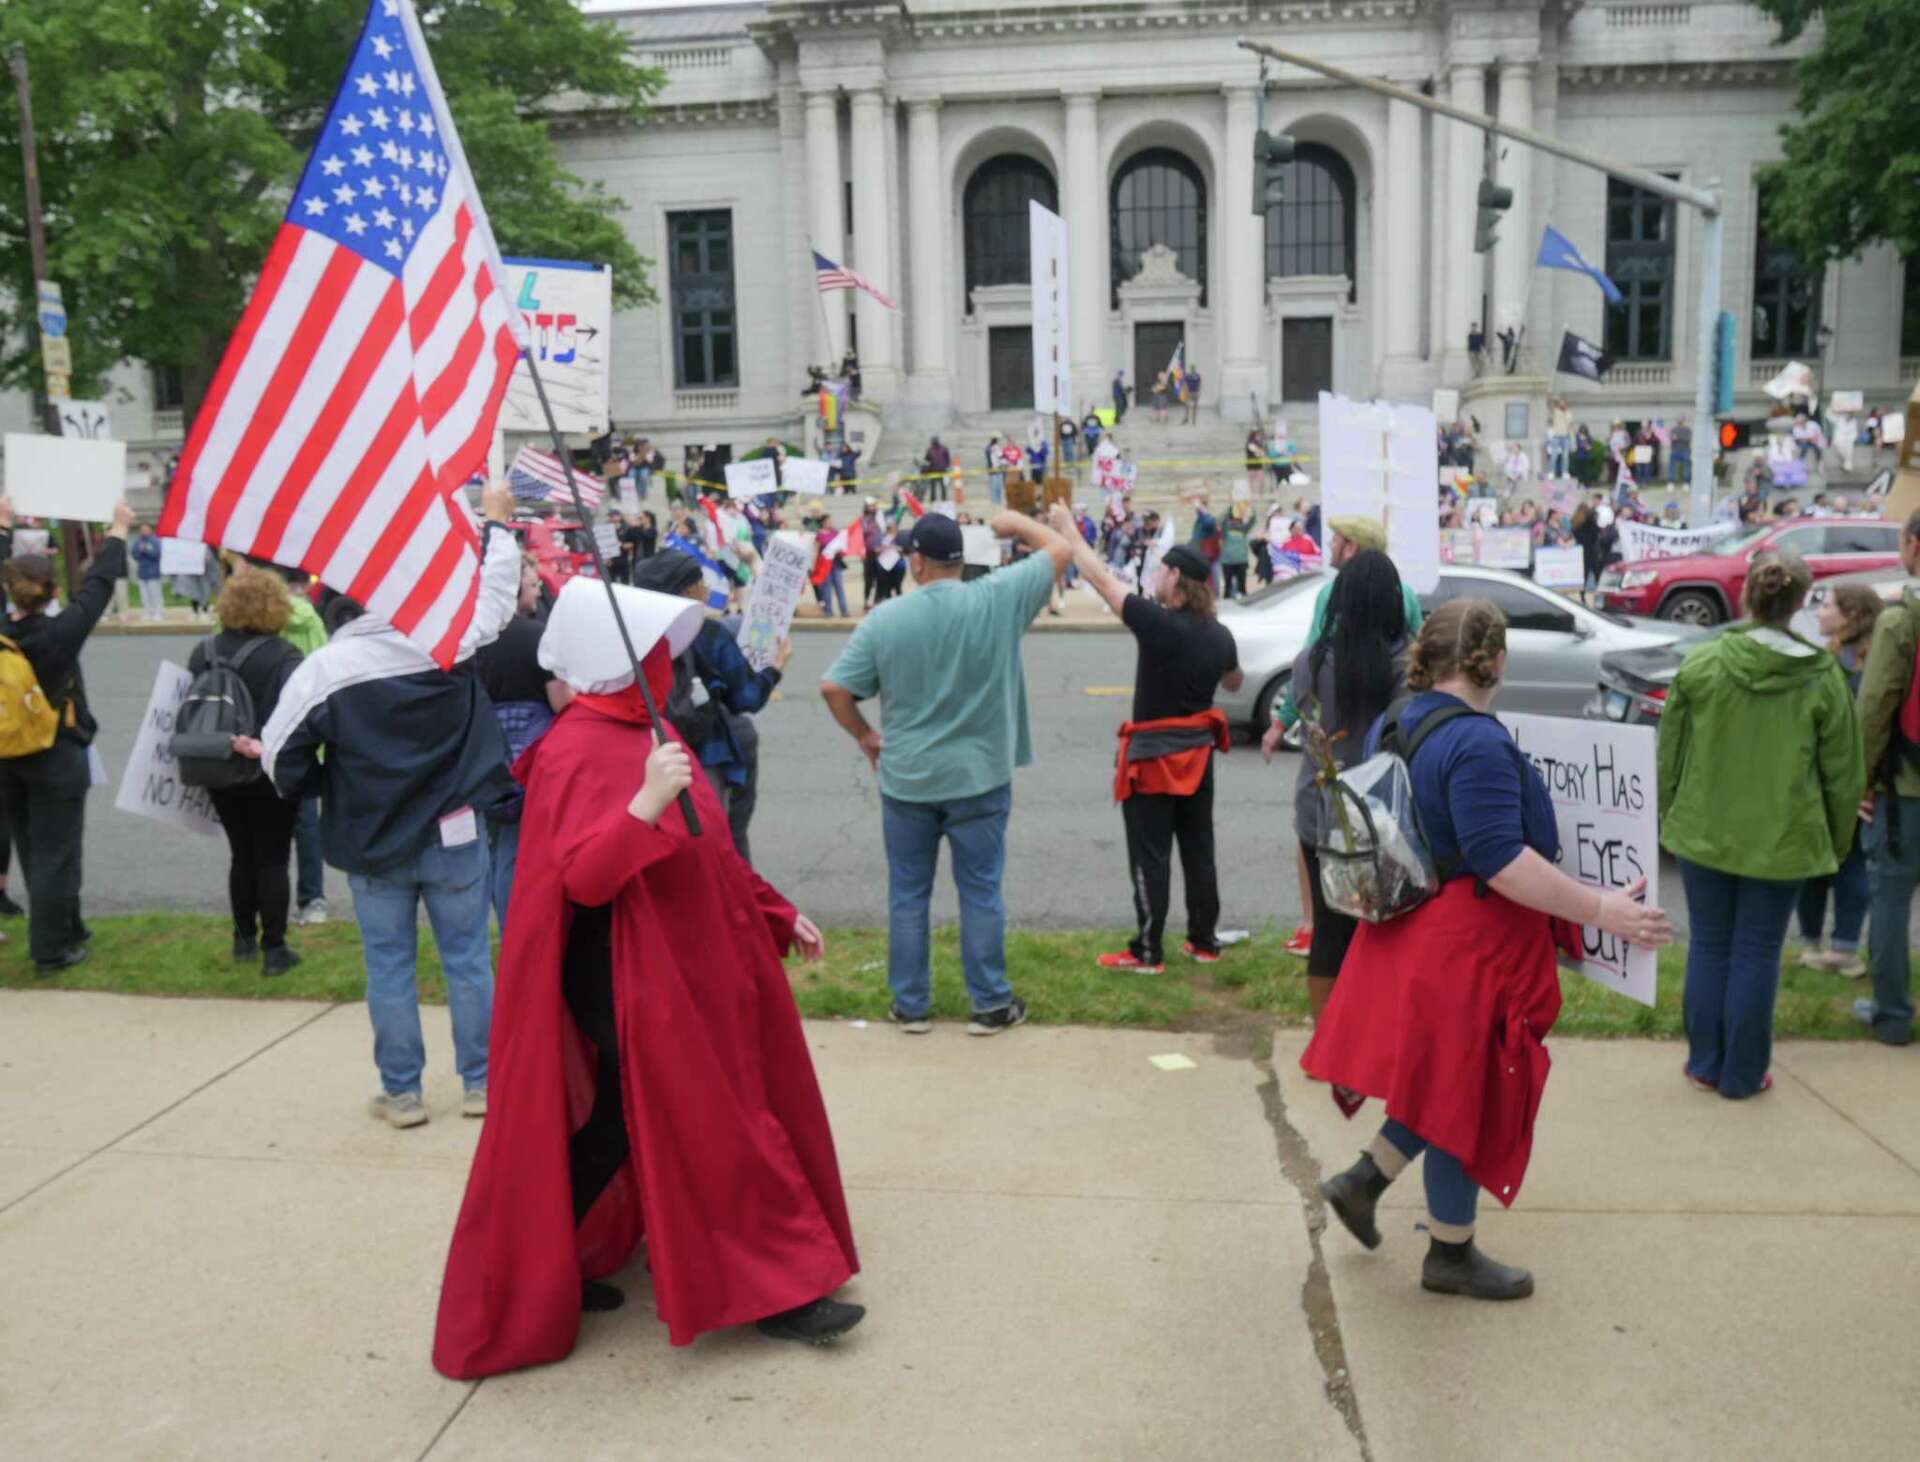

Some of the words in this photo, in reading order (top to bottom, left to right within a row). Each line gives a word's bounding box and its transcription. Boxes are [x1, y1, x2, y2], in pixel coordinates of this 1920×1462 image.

[520, 312, 577, 363] TS
[142, 772, 175, 806] NO
[1593, 743, 1645, 810] HAS
[1576, 823, 1645, 887] EYES
